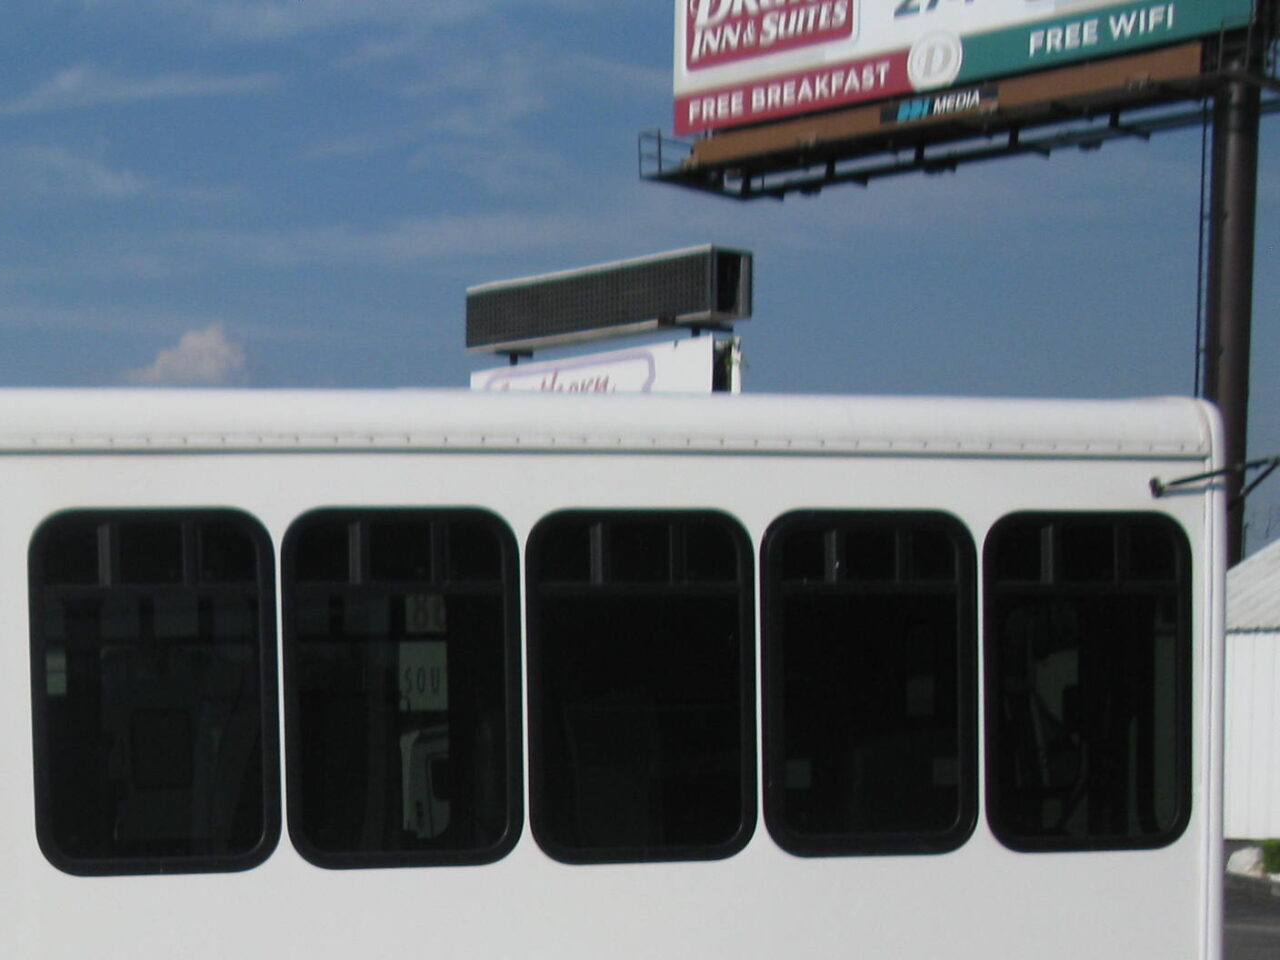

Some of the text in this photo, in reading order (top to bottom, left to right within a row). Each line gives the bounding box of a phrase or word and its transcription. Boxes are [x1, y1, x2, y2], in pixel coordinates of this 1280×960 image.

[691, 22, 741, 62] INN
[1029, 4, 1175, 58] FREE WIFI
[688, 61, 891, 126] FREE BREAKFAST
[932, 88, 980, 116] MEDIA
